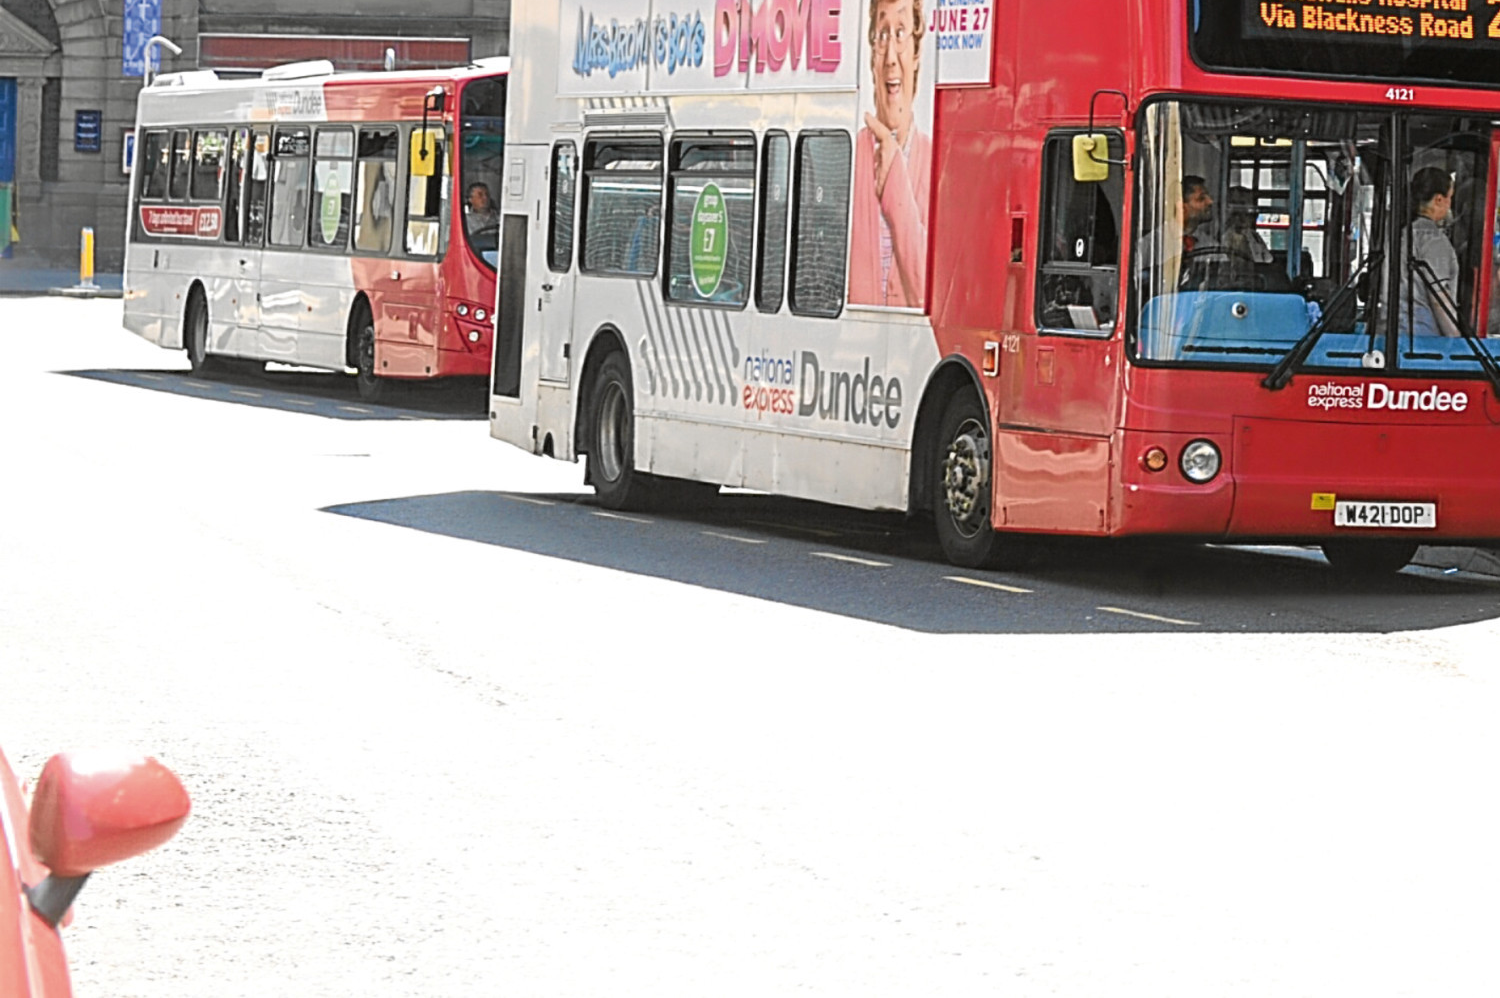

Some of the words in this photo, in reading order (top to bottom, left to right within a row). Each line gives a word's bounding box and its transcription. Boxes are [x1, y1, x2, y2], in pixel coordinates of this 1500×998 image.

[929, 8, 968, 32] JUNE
[973, 7, 990, 31] 27
[1260, 2, 1296, 29] Via
[1302, 5, 1413, 36] Blackness
[1419, 12, 1473, 39] Road
[962, 33, 984, 50] NOW
[1385, 87, 1415, 101] 4121
[1002, 334, 1021, 353] 4121
[744, 349, 797, 385] national
[798, 350, 902, 430] Dundee
[1308, 381, 1365, 397] national
[1367, 383, 1468, 412] Dundee
[743, 384, 795, 420] express
[1307, 395, 1363, 411] express
